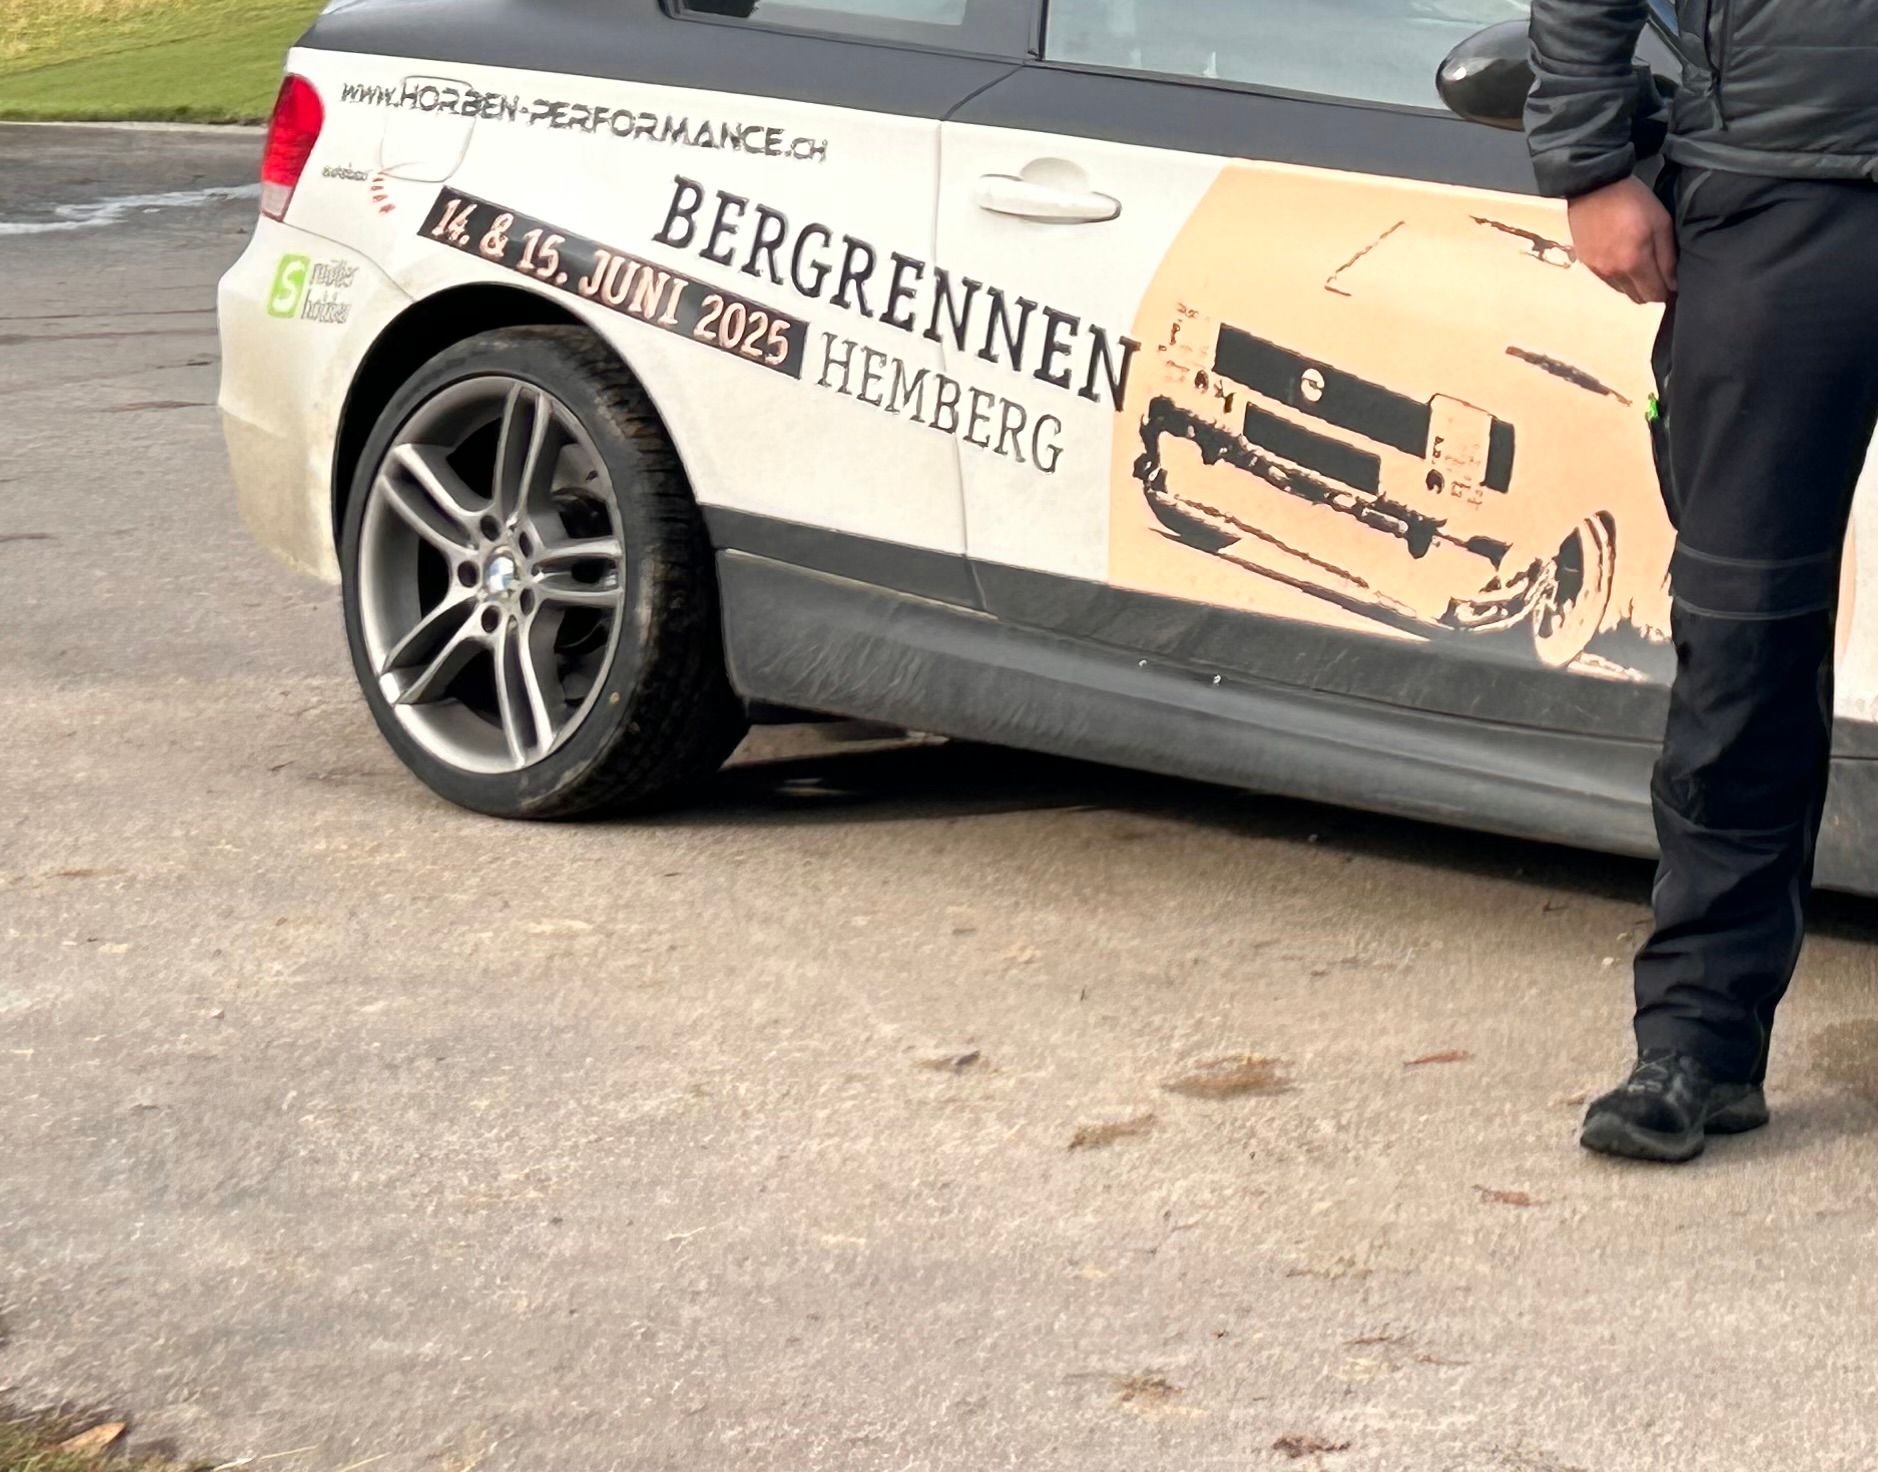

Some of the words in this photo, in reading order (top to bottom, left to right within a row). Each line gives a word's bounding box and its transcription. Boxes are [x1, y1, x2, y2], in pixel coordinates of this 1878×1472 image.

[431, 198, 477, 245] 14.
[479, 211, 514, 258] &
[516, 228, 568, 285] 15.
[578, 249, 689, 326] JUNI
[693, 294, 791, 366] 2025
[652, 173, 1141, 412] BERGRENNEN
[817, 332, 1064, 474] HEMBERG
